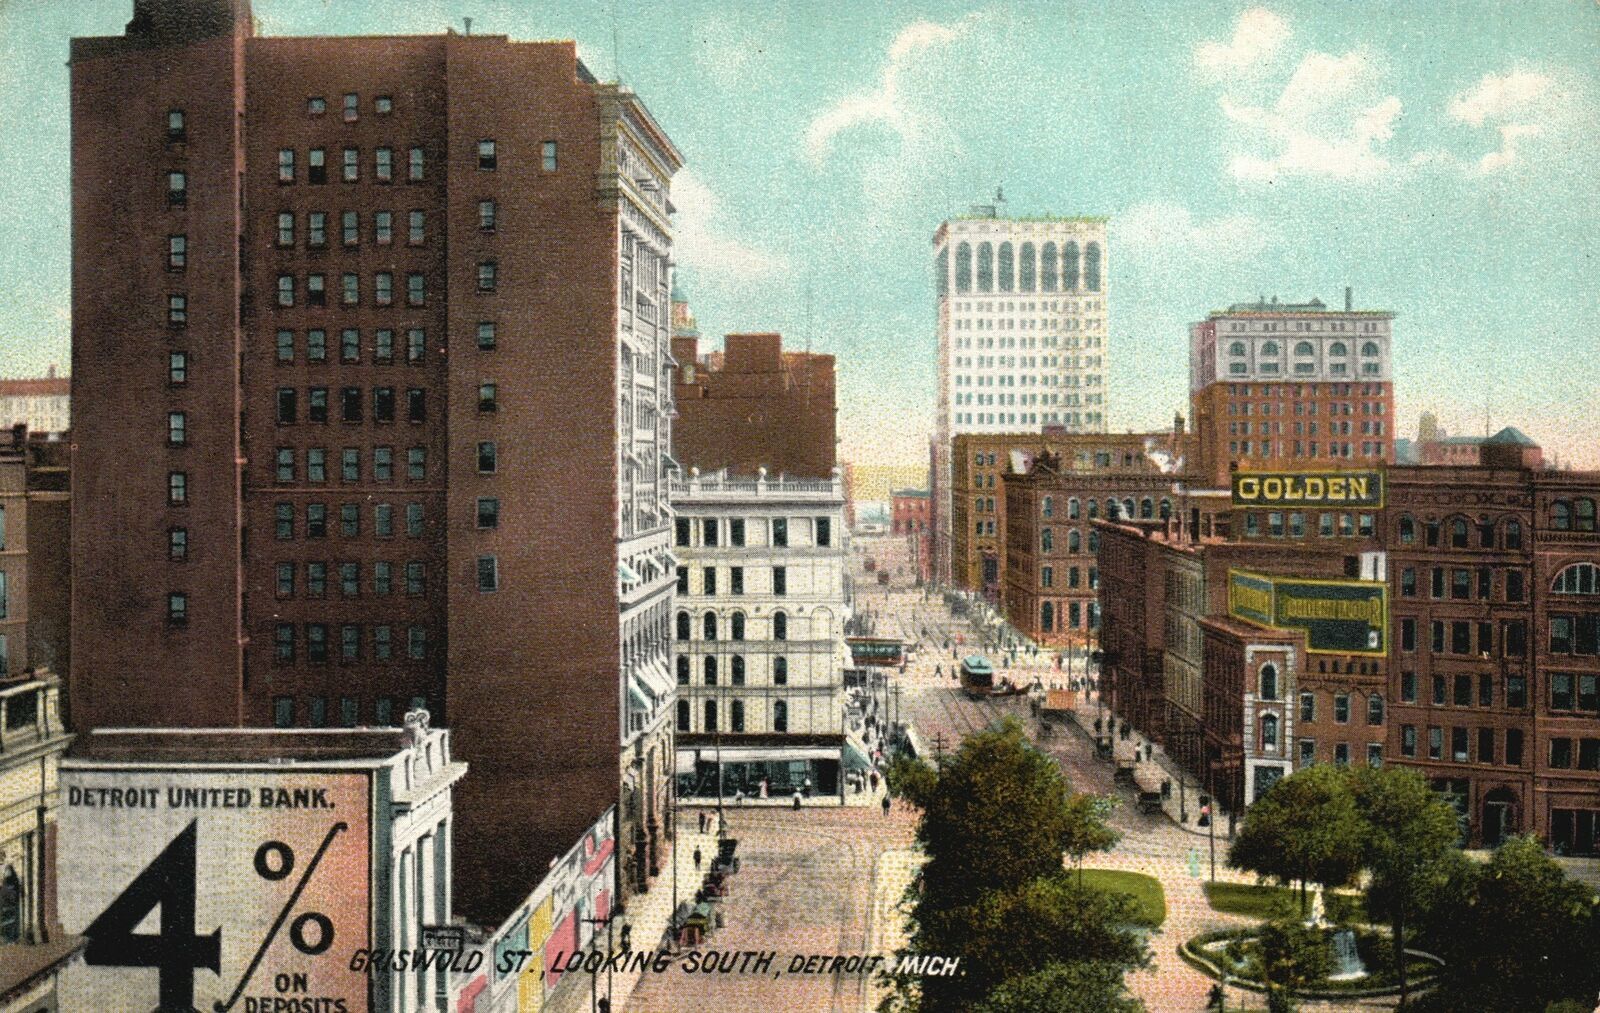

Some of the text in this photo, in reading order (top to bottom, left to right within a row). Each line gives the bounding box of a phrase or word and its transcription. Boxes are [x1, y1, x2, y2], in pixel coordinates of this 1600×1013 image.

[1239, 477, 1368, 499] GOLDEN
[69, 785, 336, 809] DETROIT UNITED BANK.
[275, 973, 308, 993] ON
[246, 997, 347, 1013] DEPOSITS
